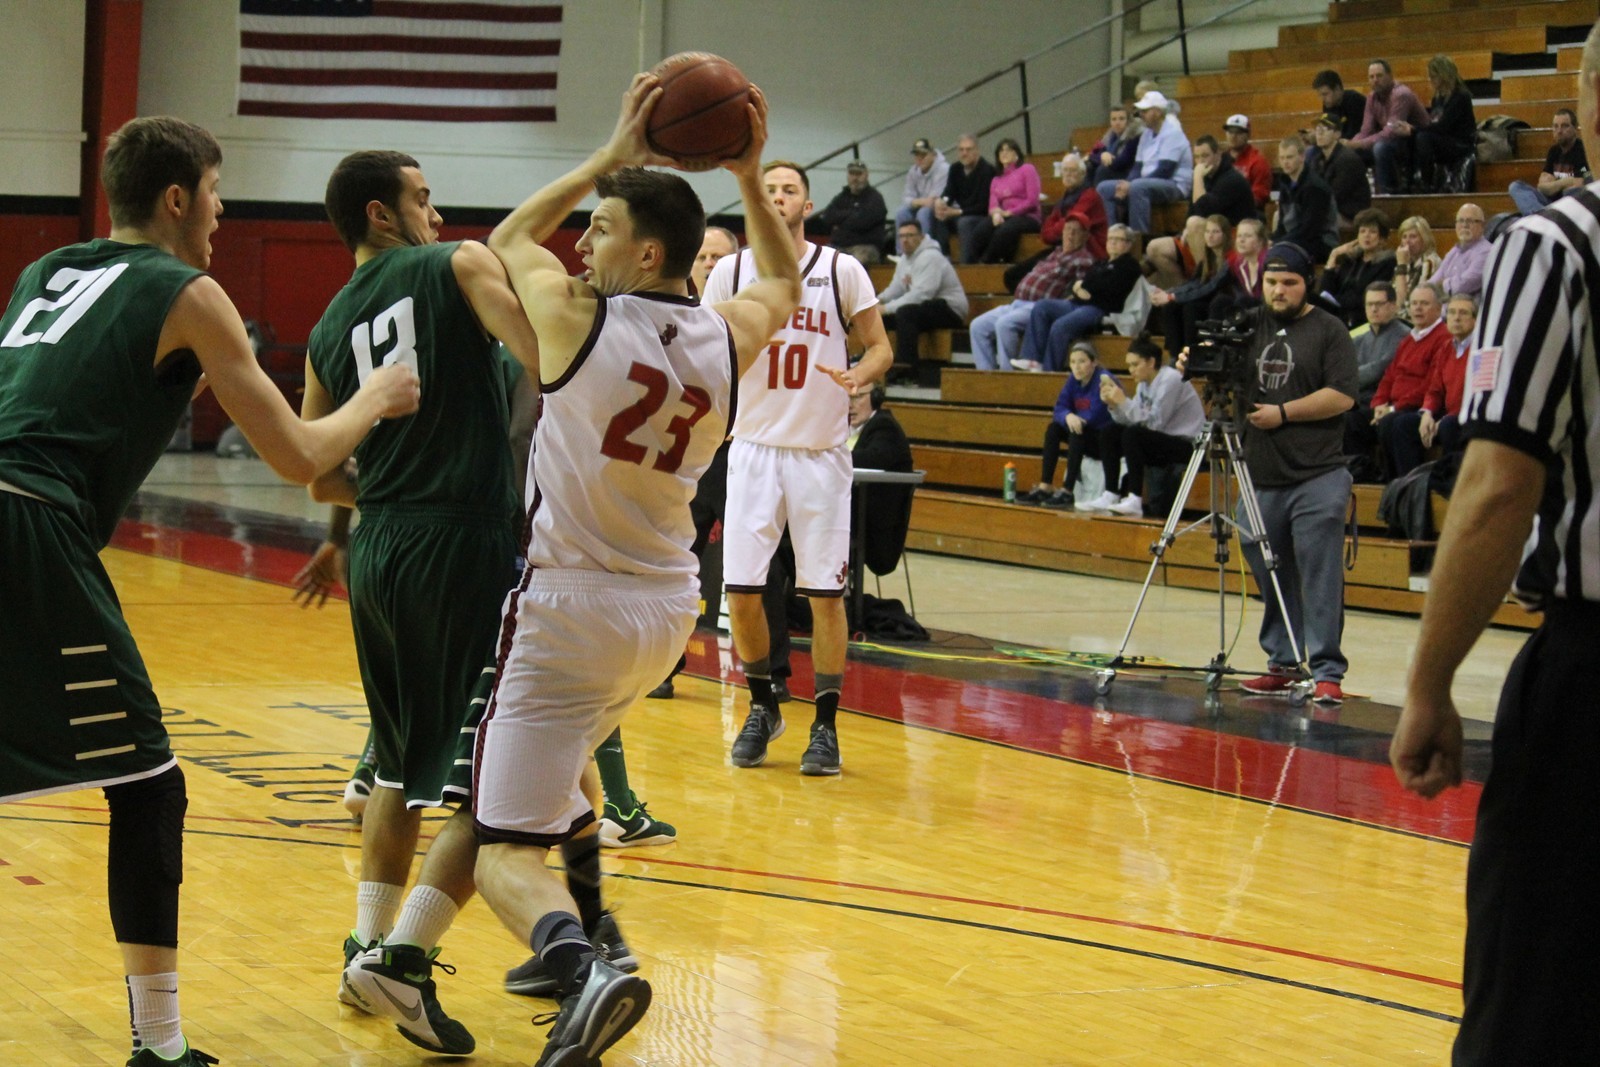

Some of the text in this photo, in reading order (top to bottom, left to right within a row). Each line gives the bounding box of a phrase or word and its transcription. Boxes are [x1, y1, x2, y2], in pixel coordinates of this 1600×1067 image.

[1, 263, 129, 348] 21
[780, 307, 830, 337] ELL
[767, 343, 809, 390] 10
[600, 360, 712, 474] 23
